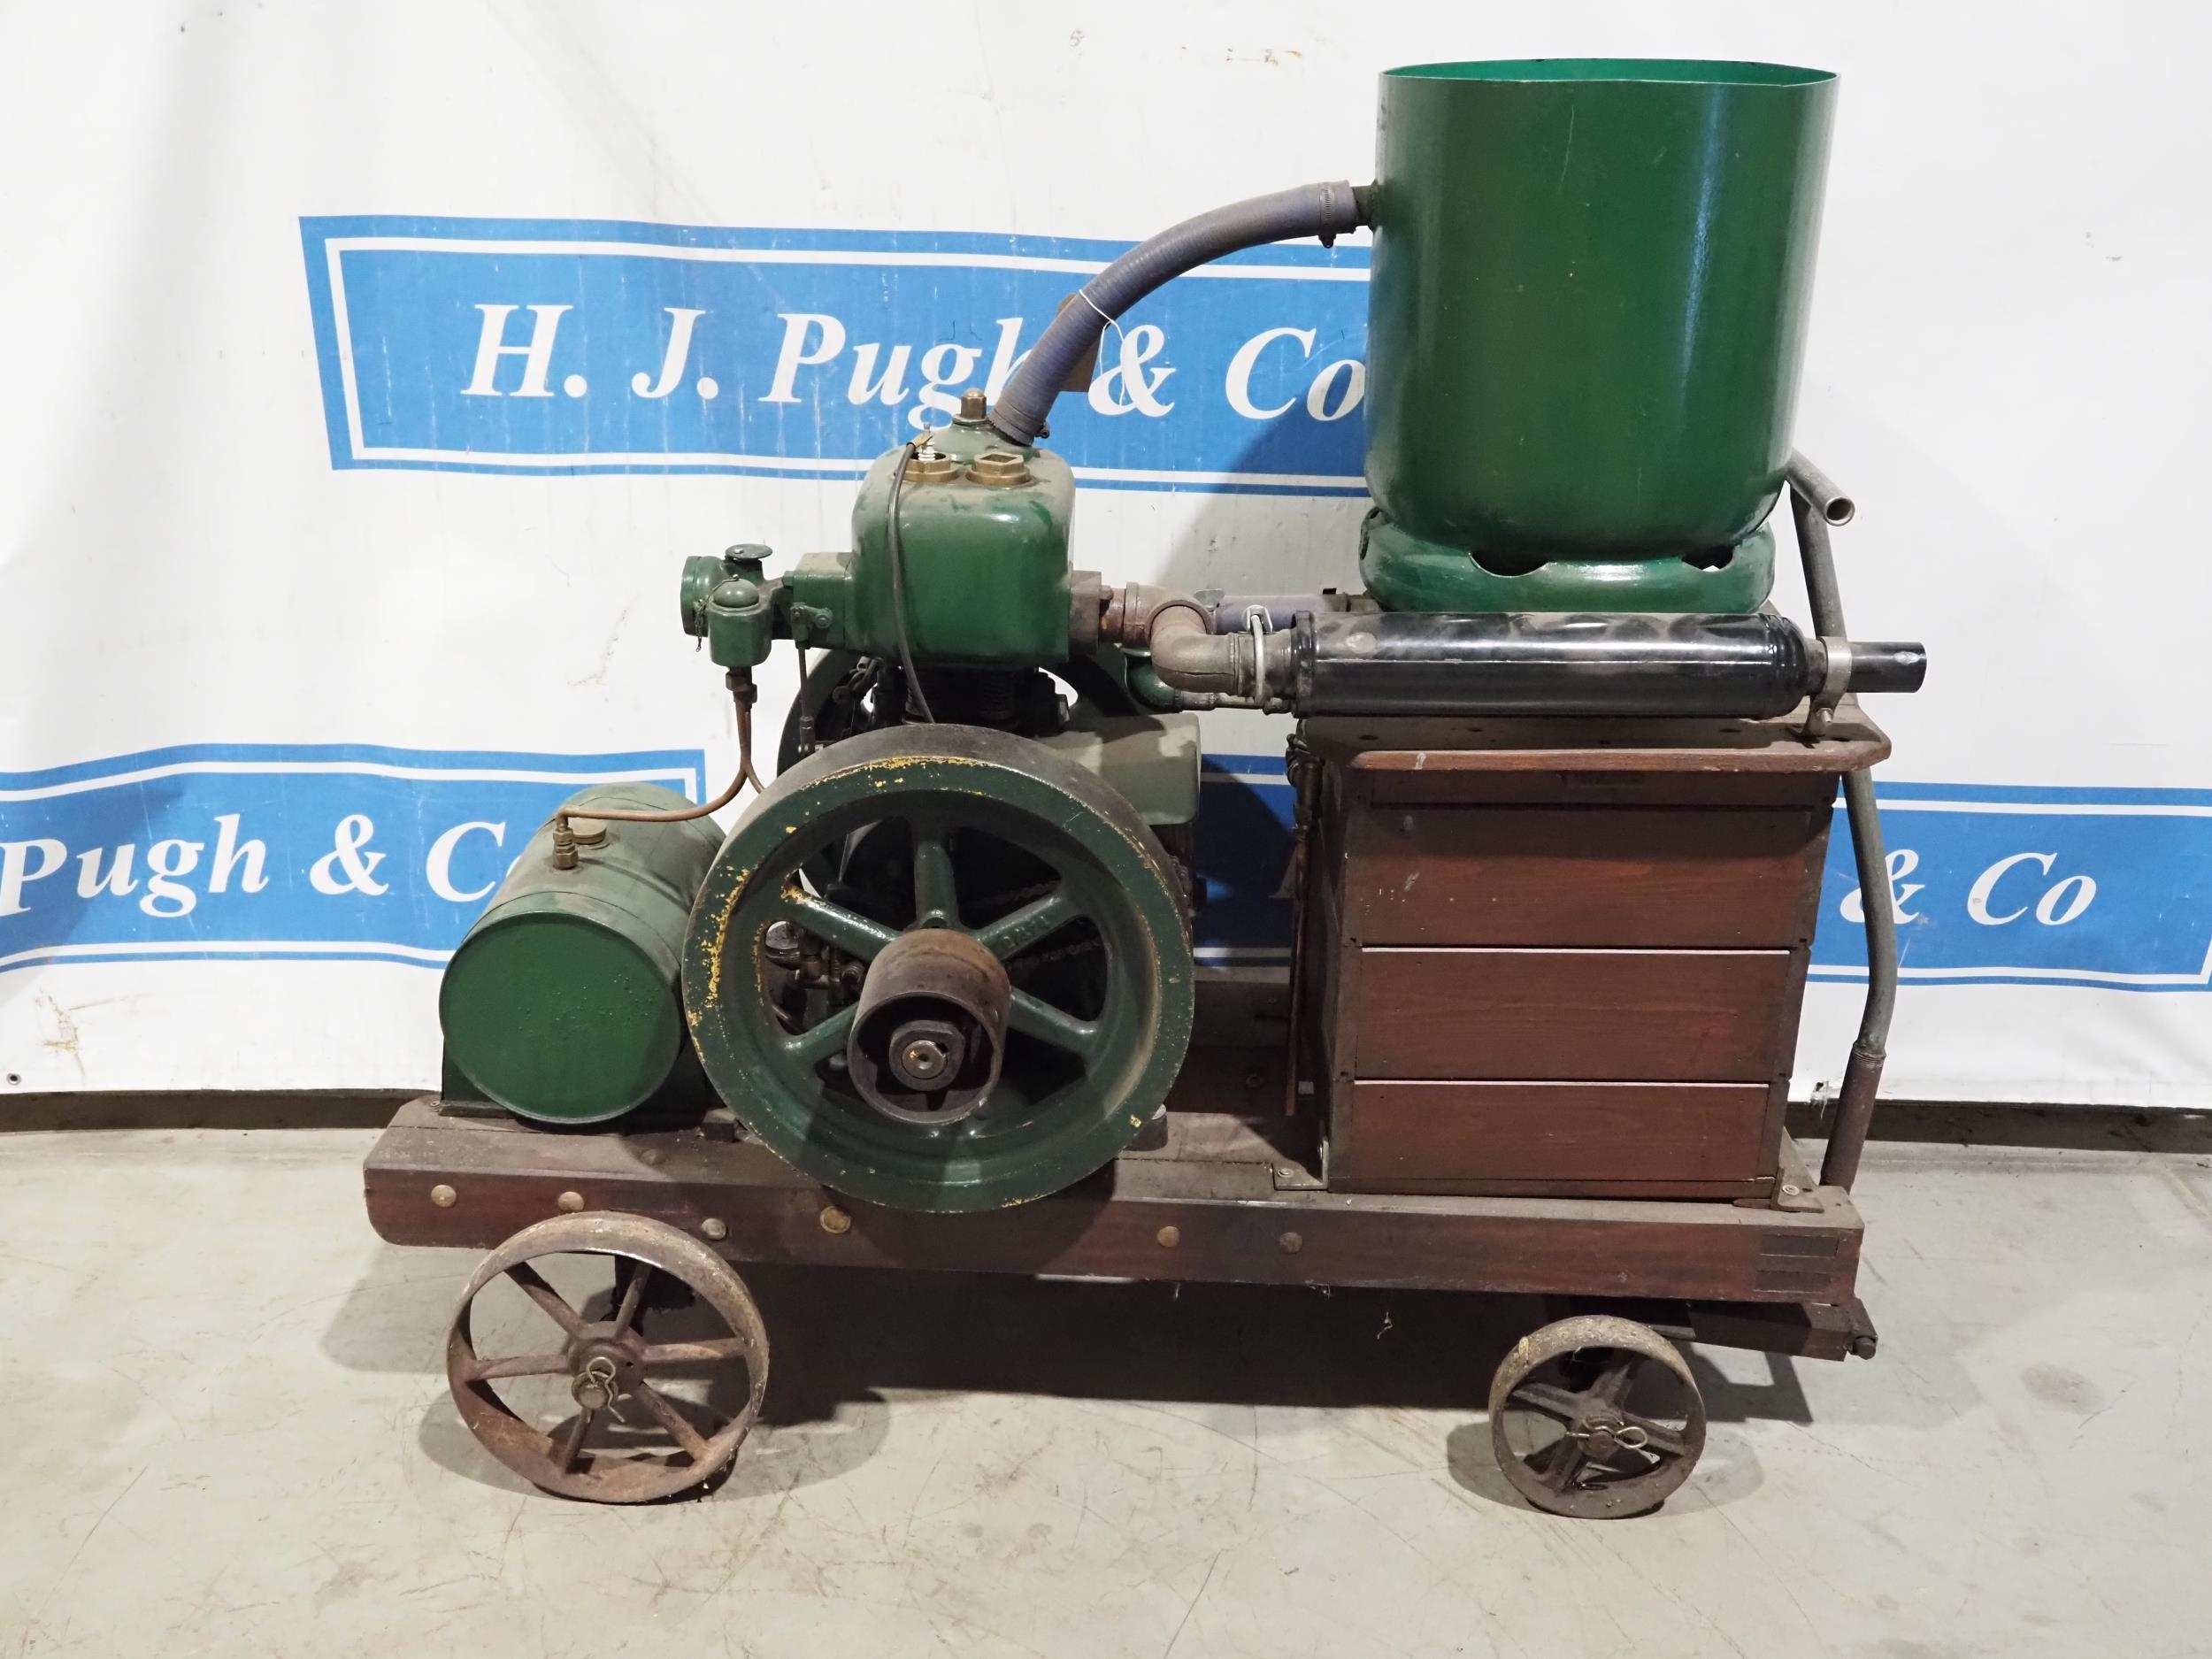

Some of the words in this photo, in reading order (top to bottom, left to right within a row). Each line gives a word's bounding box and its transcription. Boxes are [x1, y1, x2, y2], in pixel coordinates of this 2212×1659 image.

[460, 304, 588, 399] H.
[631, 307, 719, 401] J.
[1087, 324, 1177, 418] &
[1225, 326, 1365, 422] Co
[0, 813, 269, 918] Pugh
[309, 813, 389, 896] &
[426, 820, 525, 902] C
[1839, 849, 1925, 925] &
[1967, 852, 2097, 926] Co
